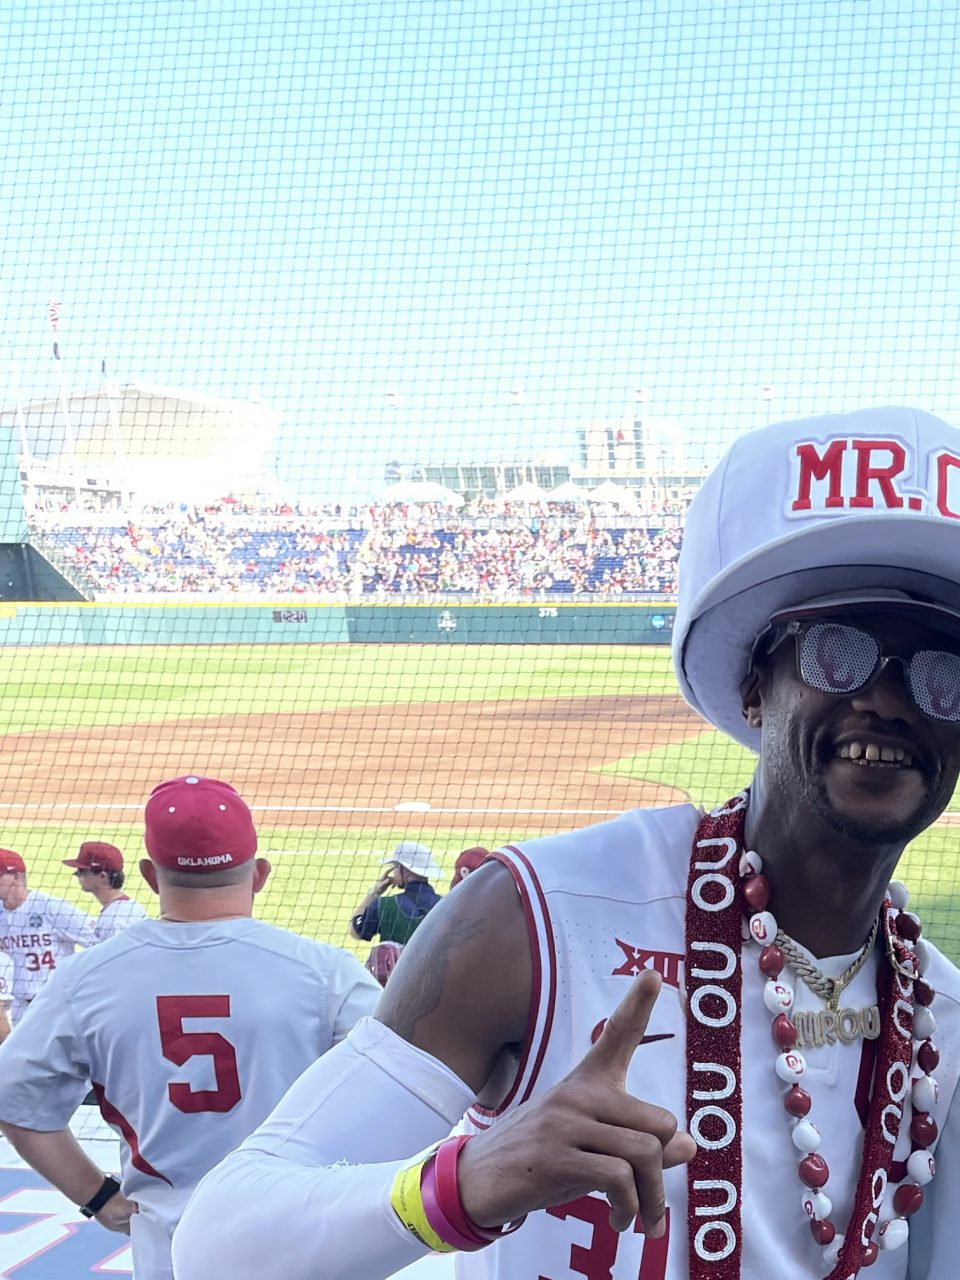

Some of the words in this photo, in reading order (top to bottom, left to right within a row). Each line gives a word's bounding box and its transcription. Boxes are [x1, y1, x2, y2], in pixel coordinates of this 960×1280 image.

[538, 607, 558, 618] 375
[177, 853, 233, 867] OKLAHOMA
[25, 950, 56, 972] 34
[156, 994, 242, 1114] 5
